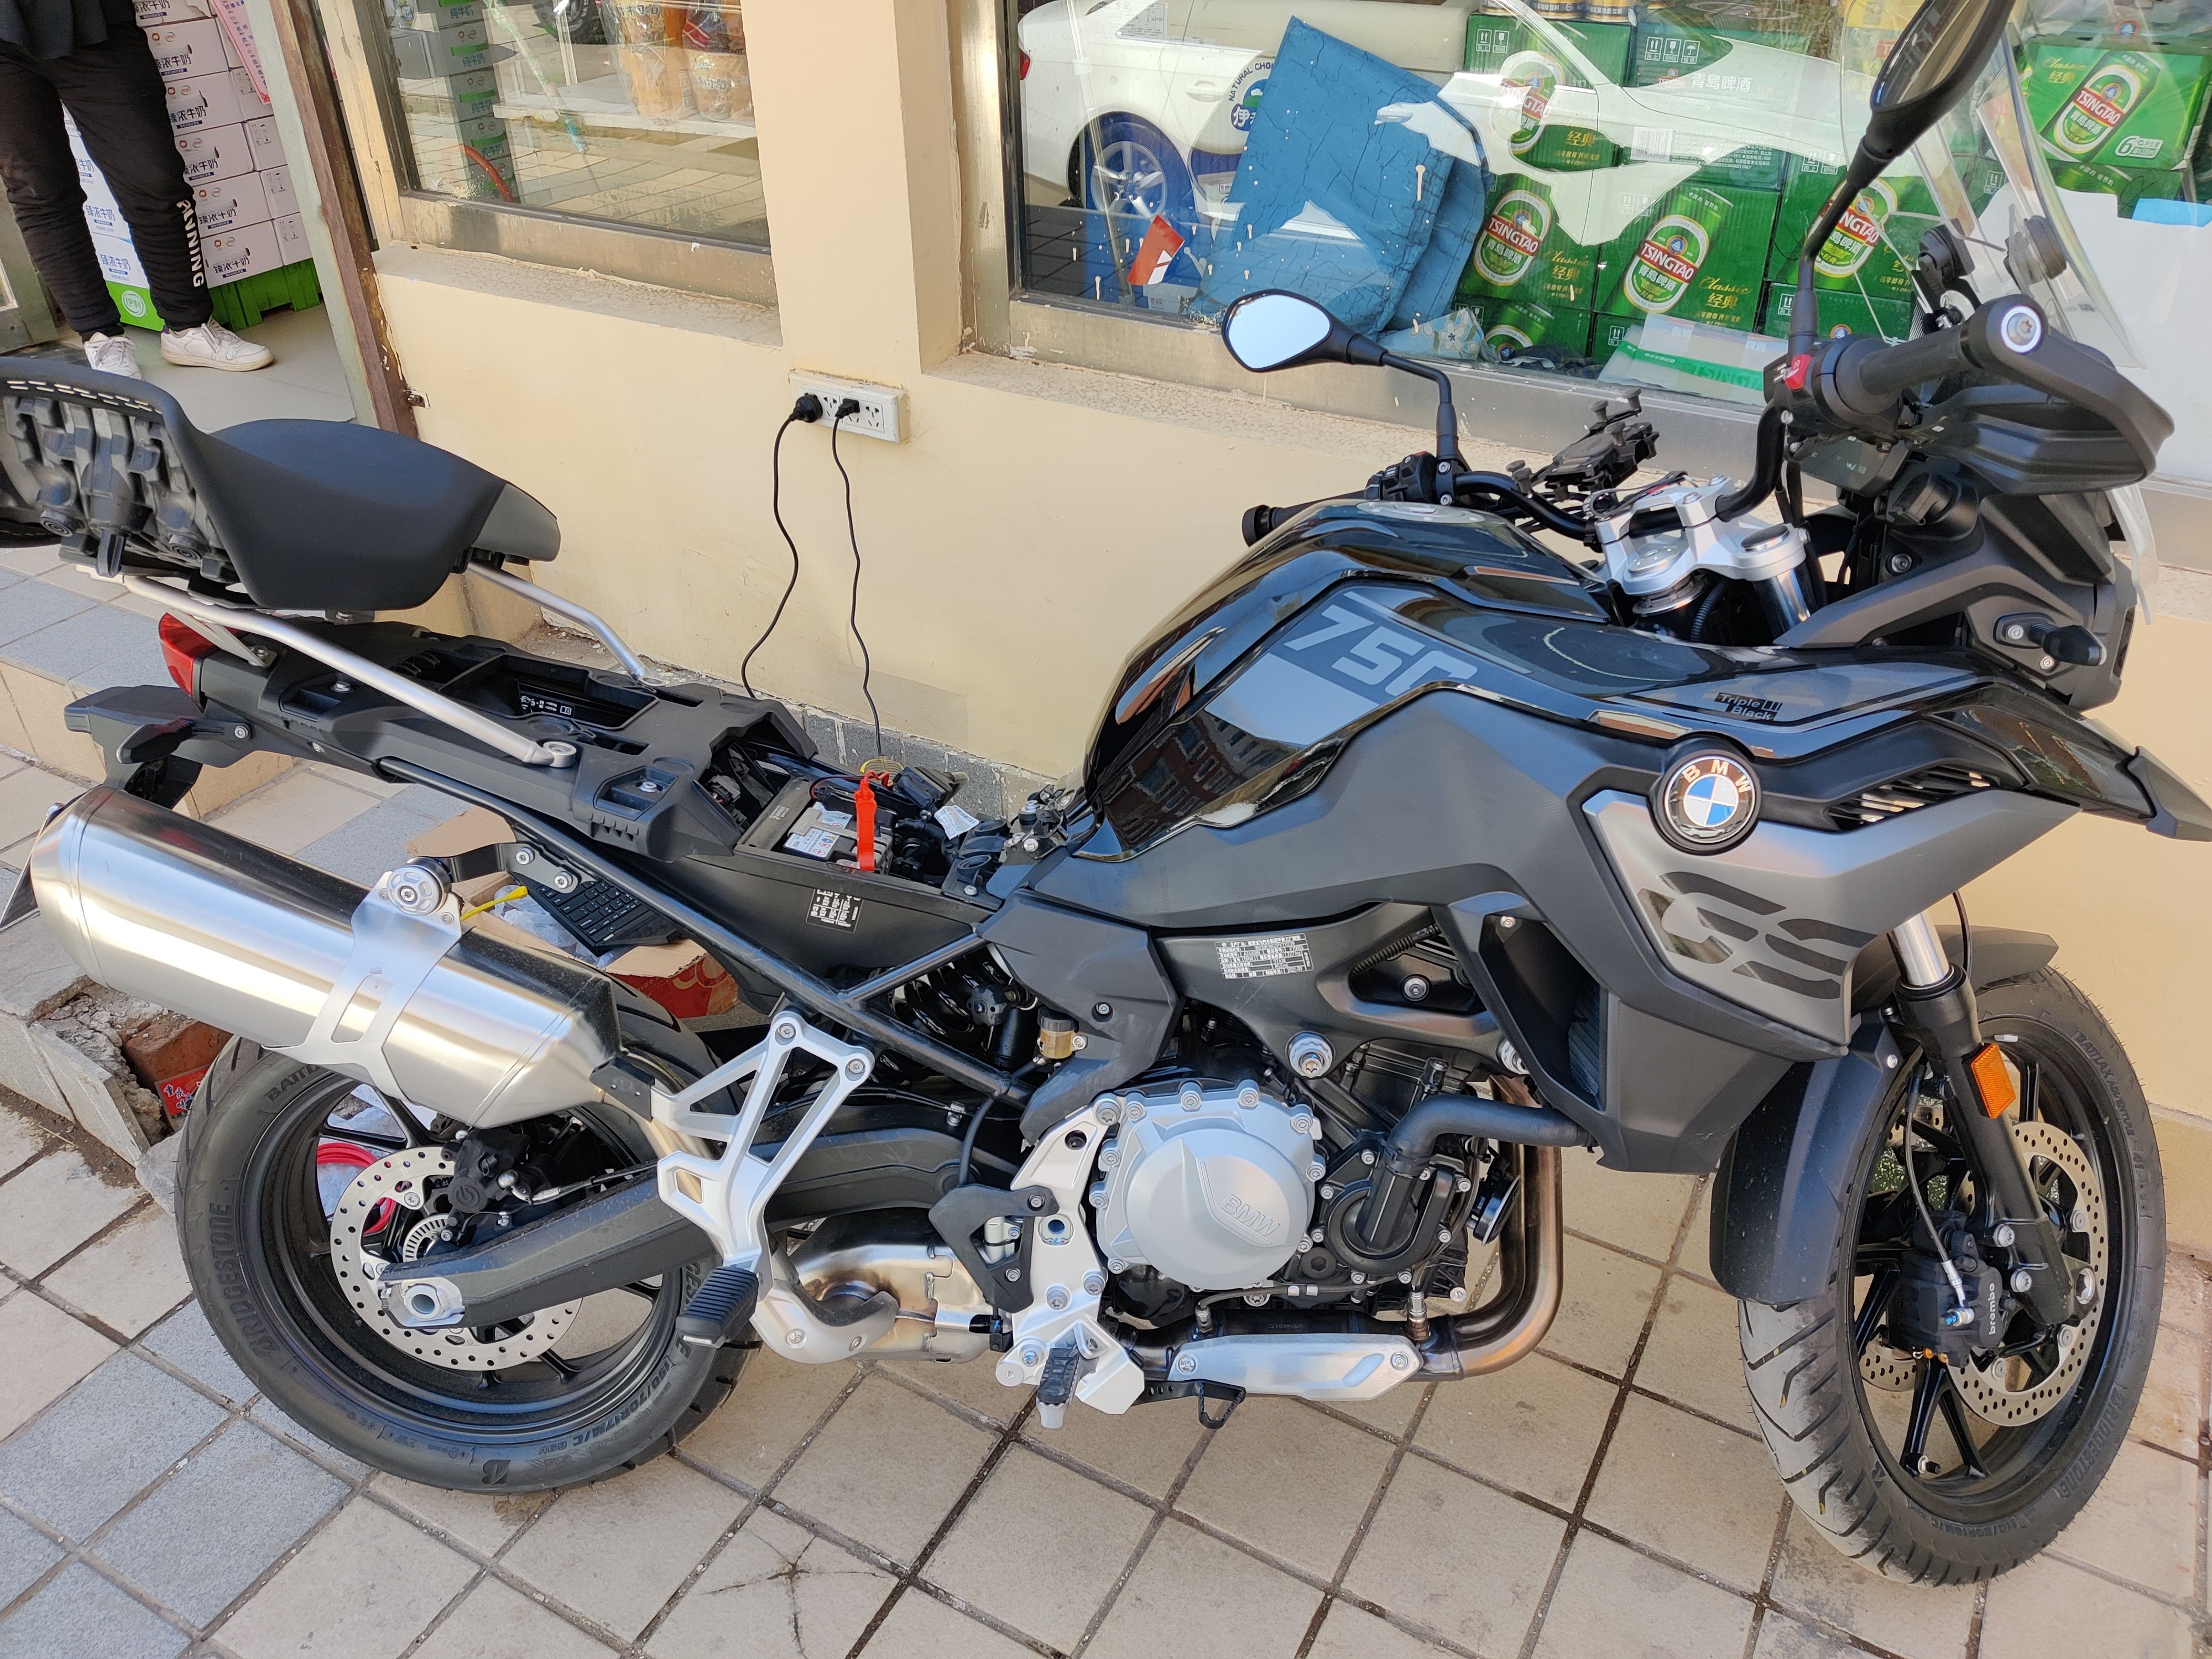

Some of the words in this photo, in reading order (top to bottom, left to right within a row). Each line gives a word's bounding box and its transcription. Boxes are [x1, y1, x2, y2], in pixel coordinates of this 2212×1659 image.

[462, 53, 485, 67] 纯牛奶
[1228, 67, 1253, 102] NATURAL
[1254, 62, 1274, 71] CHO
[1692, 73, 1752, 93] 青岛啤酒
[2077, 90, 2122, 124] TSINGTAO
[2070, 110, 2103, 135] 青岛啤酒
[1566, 131, 1597, 147] 经典
[1488, 217, 1539, 253] TSINGTAO
[1831, 231, 1863, 255] 岛啤酒
[1486, 238, 1523, 265] 青岛啤酒
[1641, 242, 1694, 280] TSINGTAO
[1551, 265, 1580, 280] 经典
[1638, 264, 1677, 292] 青岛啤酒
[1699, 275, 1752, 294] Classic
[126, 299, 142, 309] 伊利
[1708, 292, 1738, 309] 经典
[1691, 361, 1764, 388] TSINGT
[1719, 693, 1761, 708] Triple
[1730, 705, 1773, 721] Black
[1682, 760, 1752, 793] BMW
[2073, 1029, 2114, 1078] BATTLAX
[1219, 1193, 1281, 1238] BMW
[210, 1202, 280, 1359] BRIDGESTONE
[1987, 1282, 1996, 1336] brembo
[2058, 1384, 2126, 1499] BRIDGESTONE
